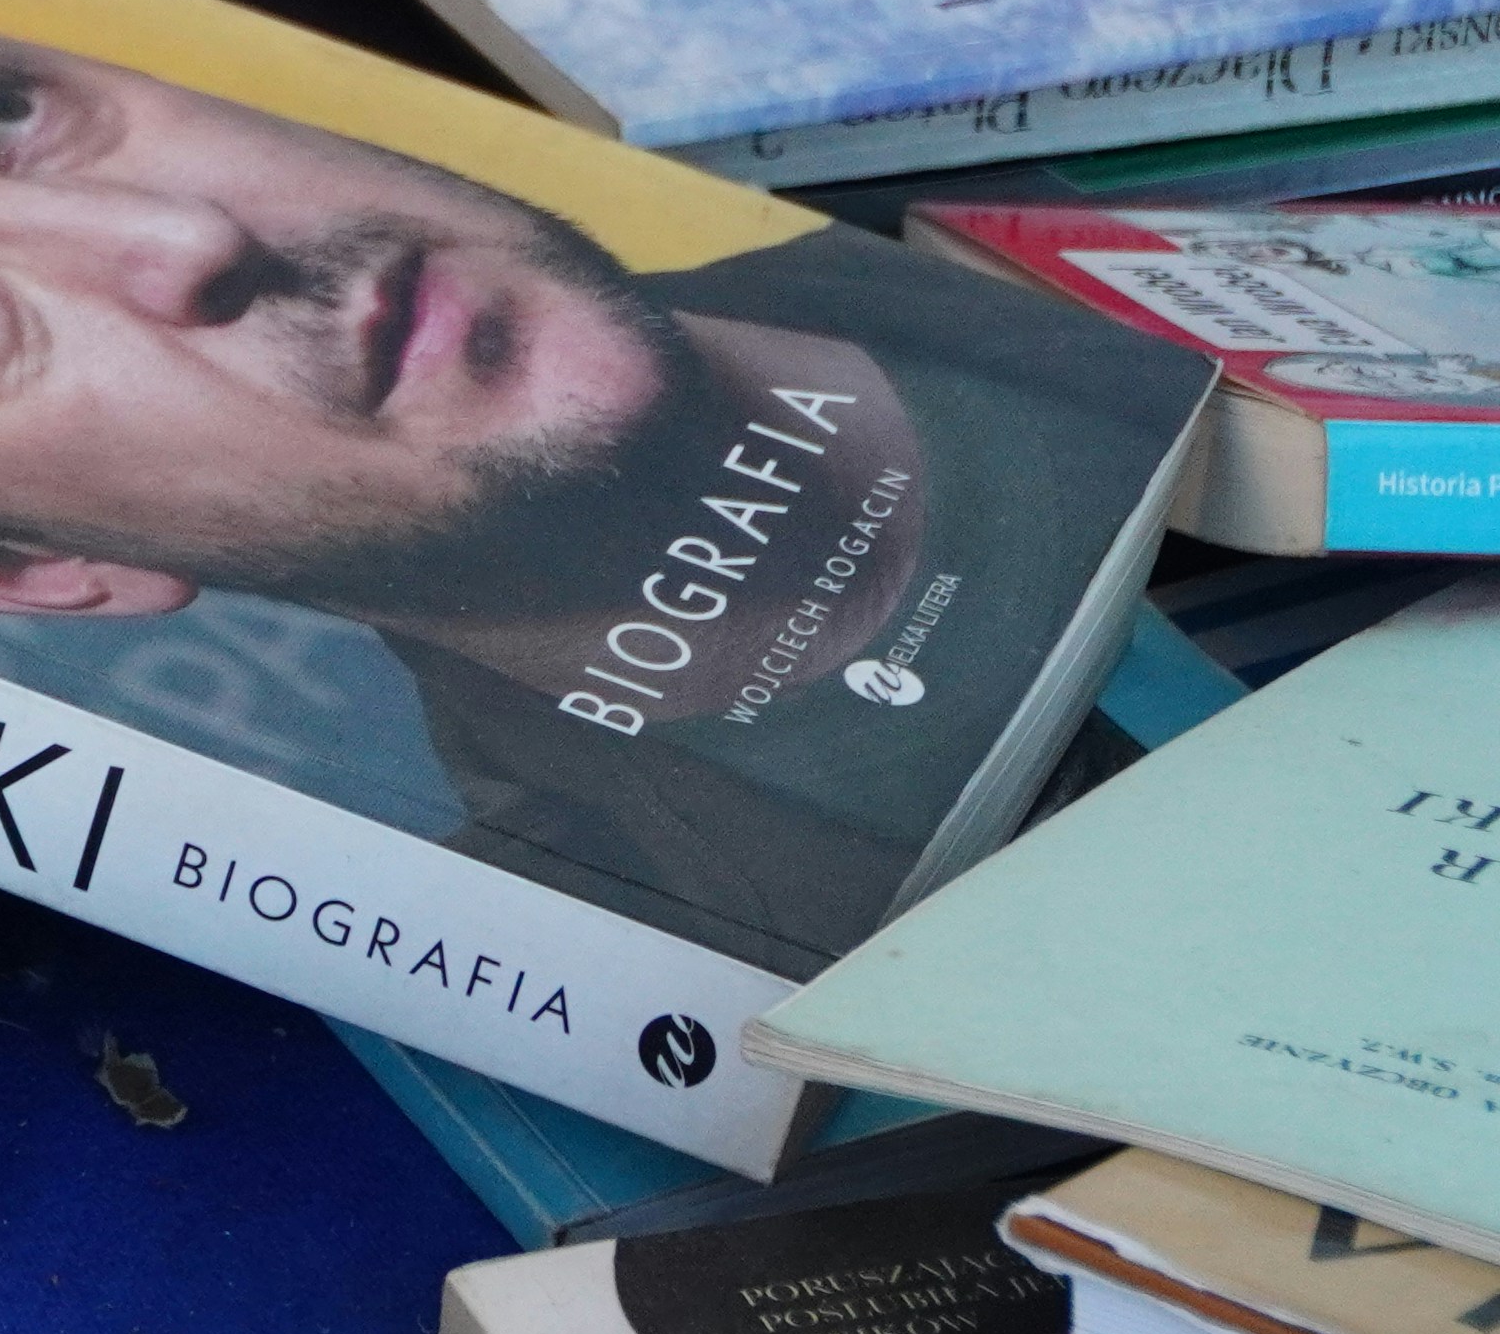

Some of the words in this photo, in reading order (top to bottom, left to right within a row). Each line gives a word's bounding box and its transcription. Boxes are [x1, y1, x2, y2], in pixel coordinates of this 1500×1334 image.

[557, 384, 857, 737] BIOGRAFIA
[723, 598, 831, 725] WOJCIECH
[813, 467, 912, 595] ROGACIN
[1378, 471, 1481, 498] Historia
[173, 842, 573, 1035] BIOGRAFIA
